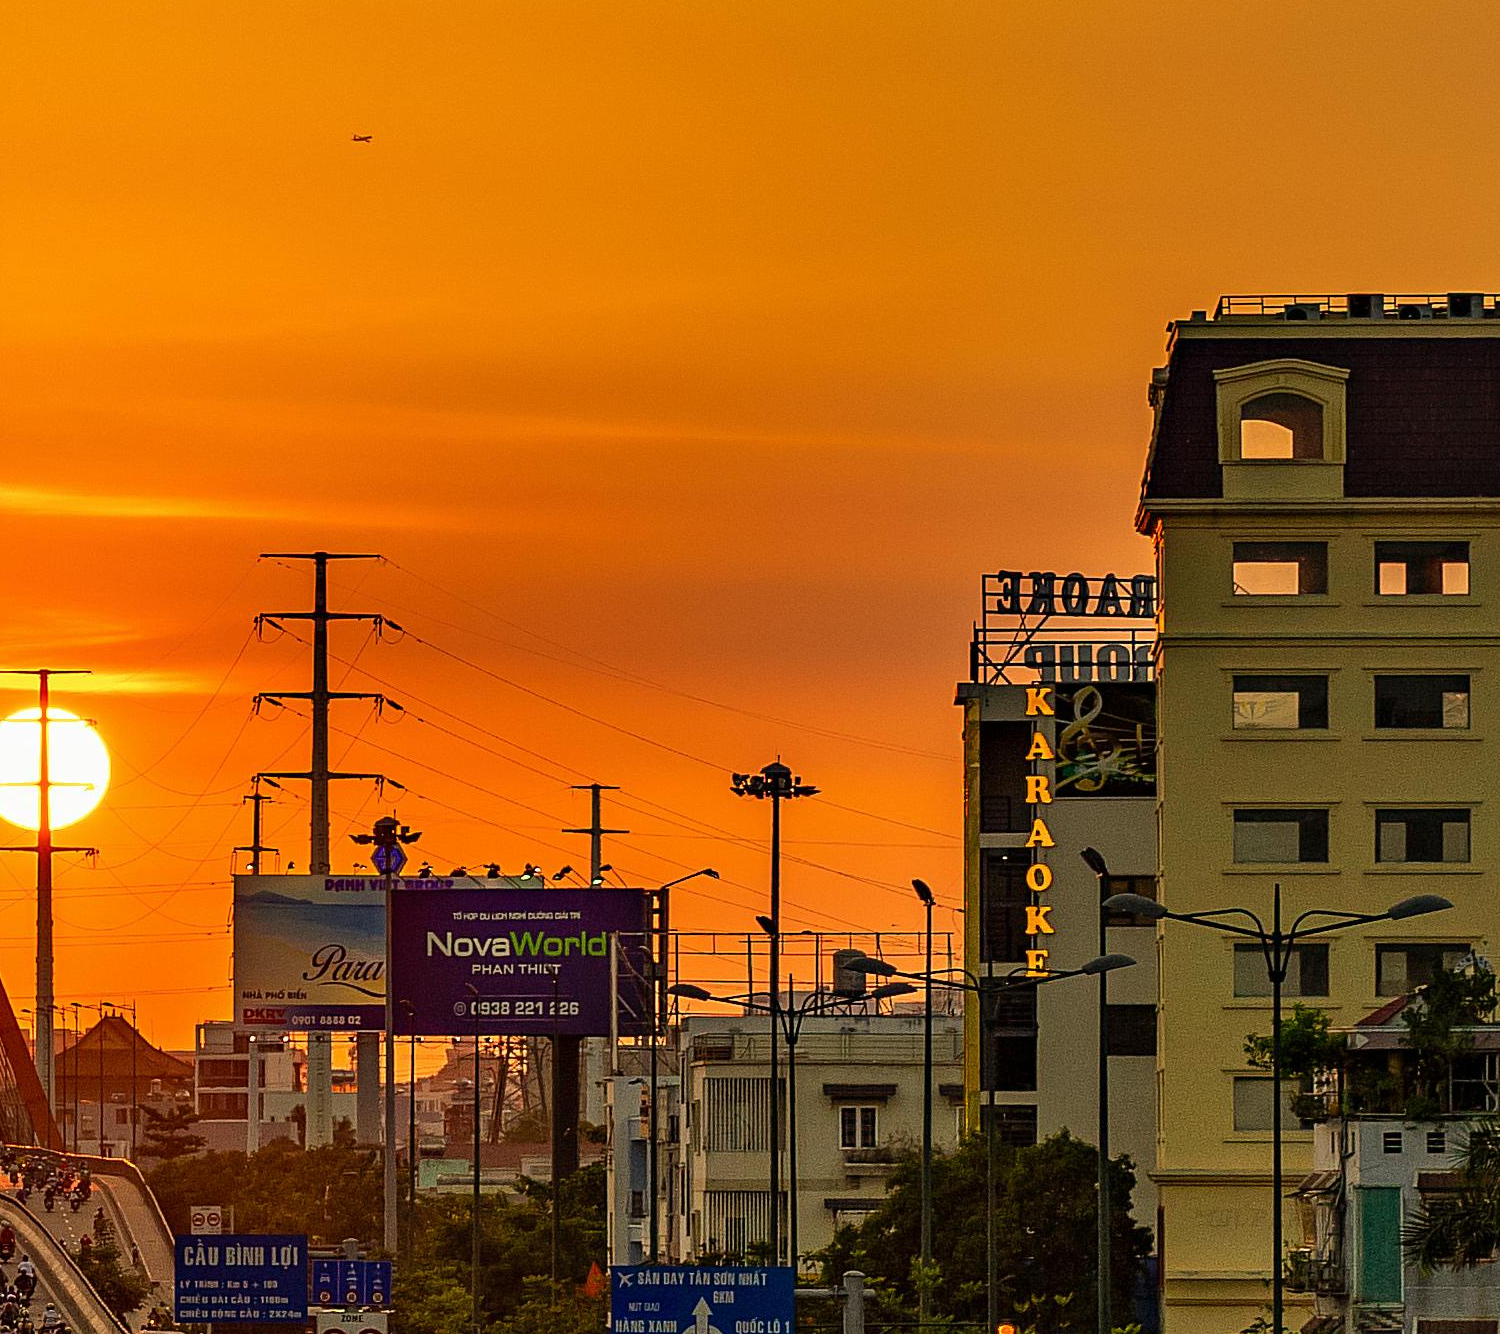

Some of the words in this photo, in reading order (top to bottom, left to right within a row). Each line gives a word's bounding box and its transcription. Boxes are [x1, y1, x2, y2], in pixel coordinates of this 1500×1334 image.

[1025, 687, 1056, 978] KARAOKE
[427, 931, 607, 958] NovaWorld
[472, 964, 514, 975] PHAN
[243, 988, 262, 999] NHÀ
[515, 1001, 543, 1015] 221
[292, 1015, 315, 1025] 0901
[347, 1015, 361, 1025] 02
[184, 1238, 219, 1266] CẦU
[225, 1243, 265, 1266] BÌNH
[271, 1244, 298, 1269] LỢI
[638, 1269, 660, 1285] SÂN
[689, 1269, 710, 1285] TÂN
[714, 1270, 735, 1285] SƠN
[739, 1268, 767, 1286] NHẤT
[713, 1291, 734, 1304] 6KM
[341, 1314, 364, 1323] ZONE
[616, 1317, 645, 1332] HÀNG
[648, 1320, 677, 1333] XANH
[735, 1317, 764, 1334] QUỐC
[785, 1320, 790, 1334] 1
